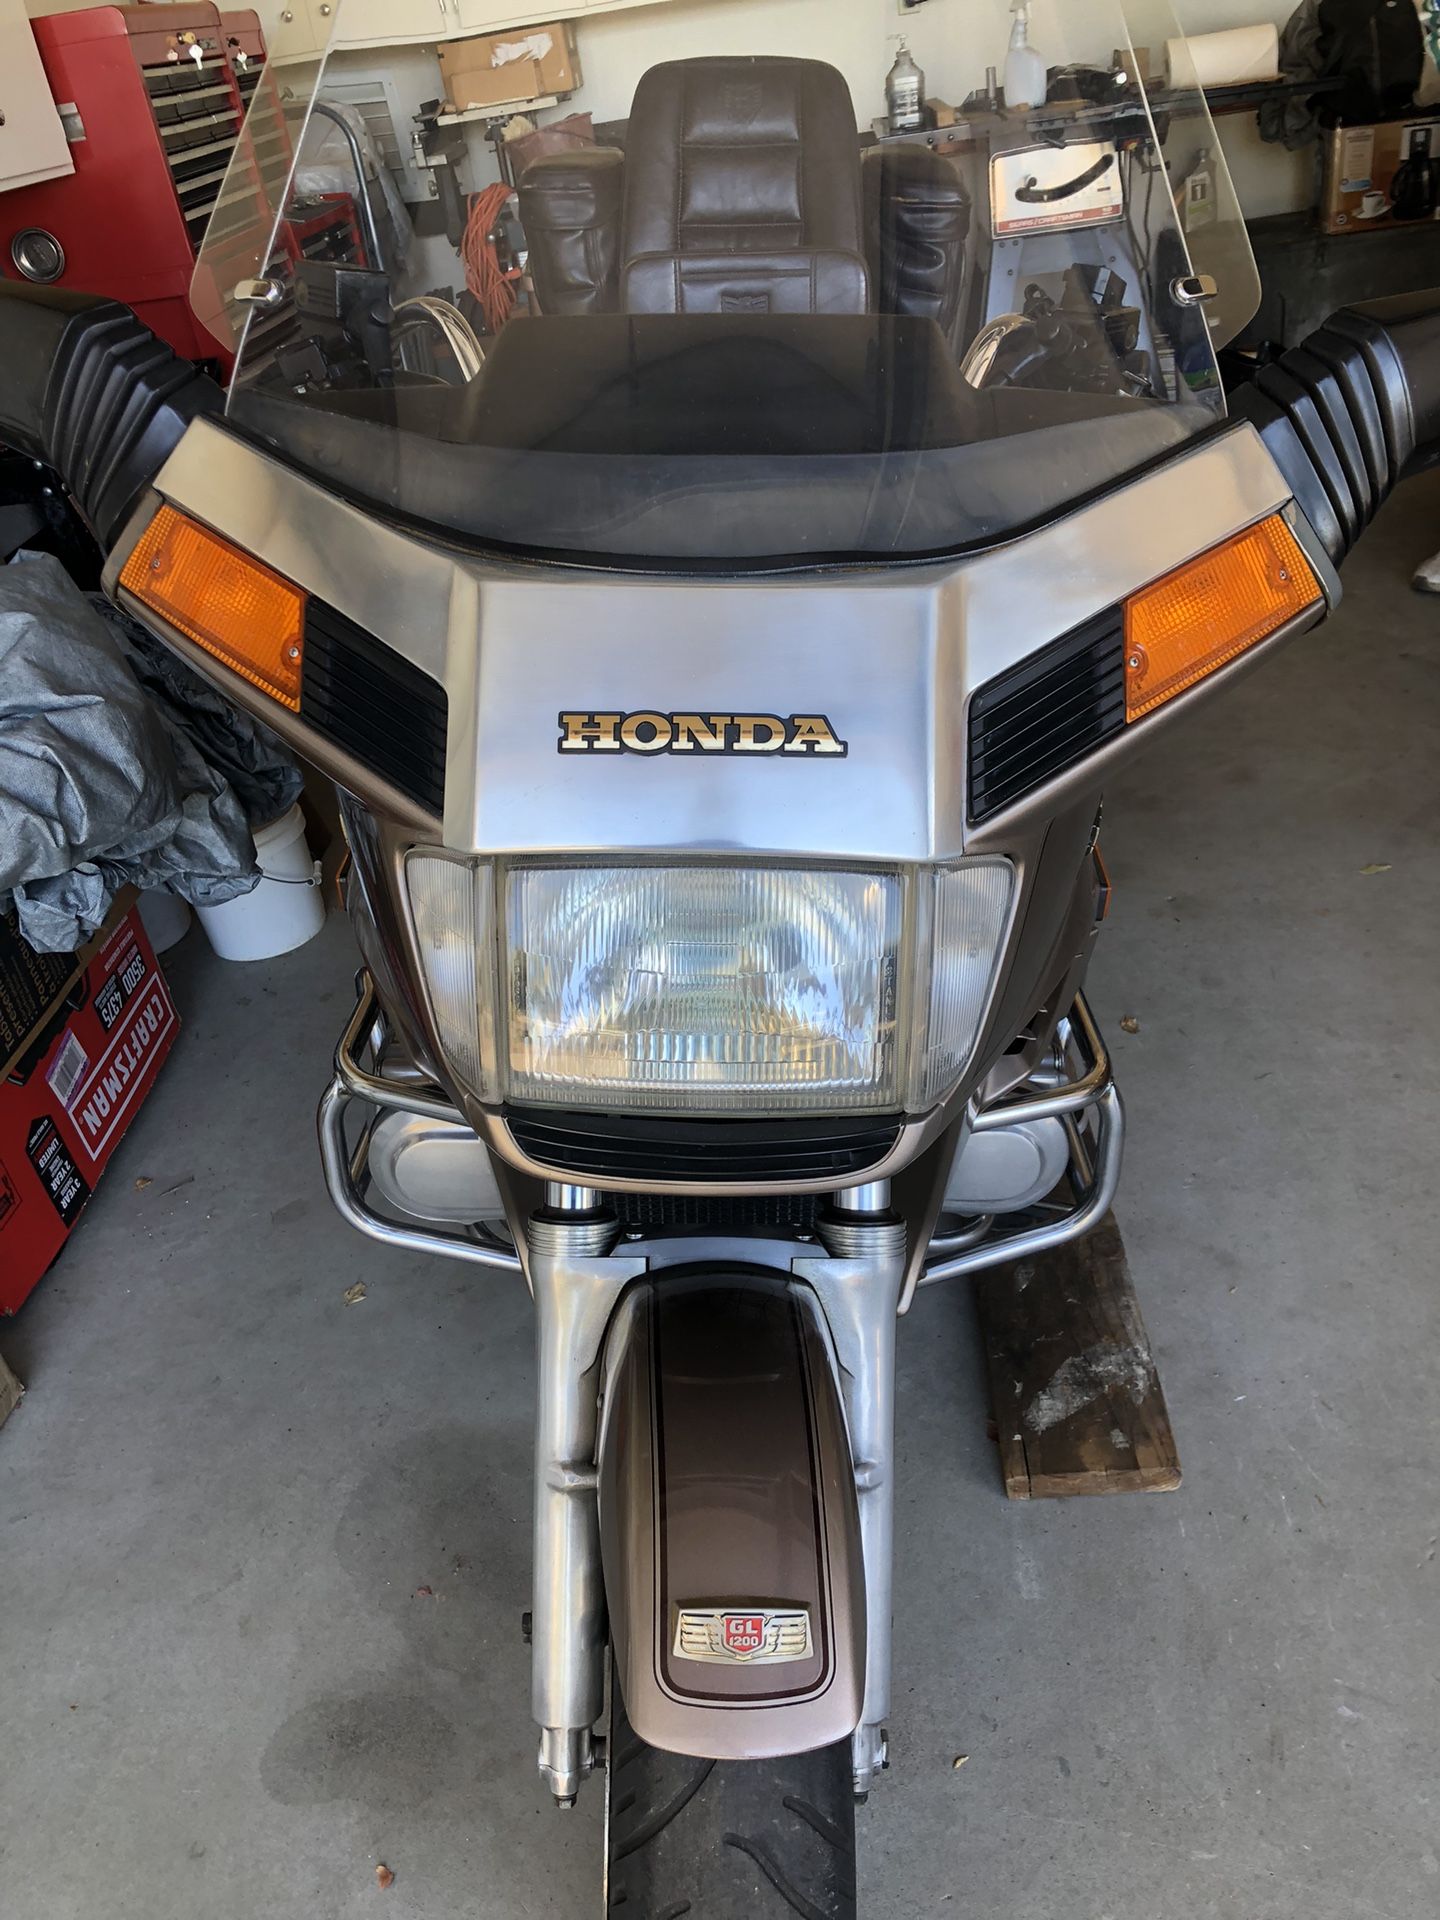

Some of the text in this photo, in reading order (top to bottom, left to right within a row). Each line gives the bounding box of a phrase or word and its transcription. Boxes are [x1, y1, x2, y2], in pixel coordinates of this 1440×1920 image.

[559, 711, 847, 756] HONDA
[122, 954, 146, 996] 3500
[101, 991, 123, 1029] 4375
[82, 994, 164, 1136] CRAFTSMAN
[38, 1137, 60, 1169] LIMITED
[64, 1160, 71, 1171] 2
[50, 1166, 68, 1192] YEAR
[60, 1178, 81, 1210] 3 YEAR
[729, 1619, 758, 1634] GL
[729, 1636, 759, 1647] 1200
